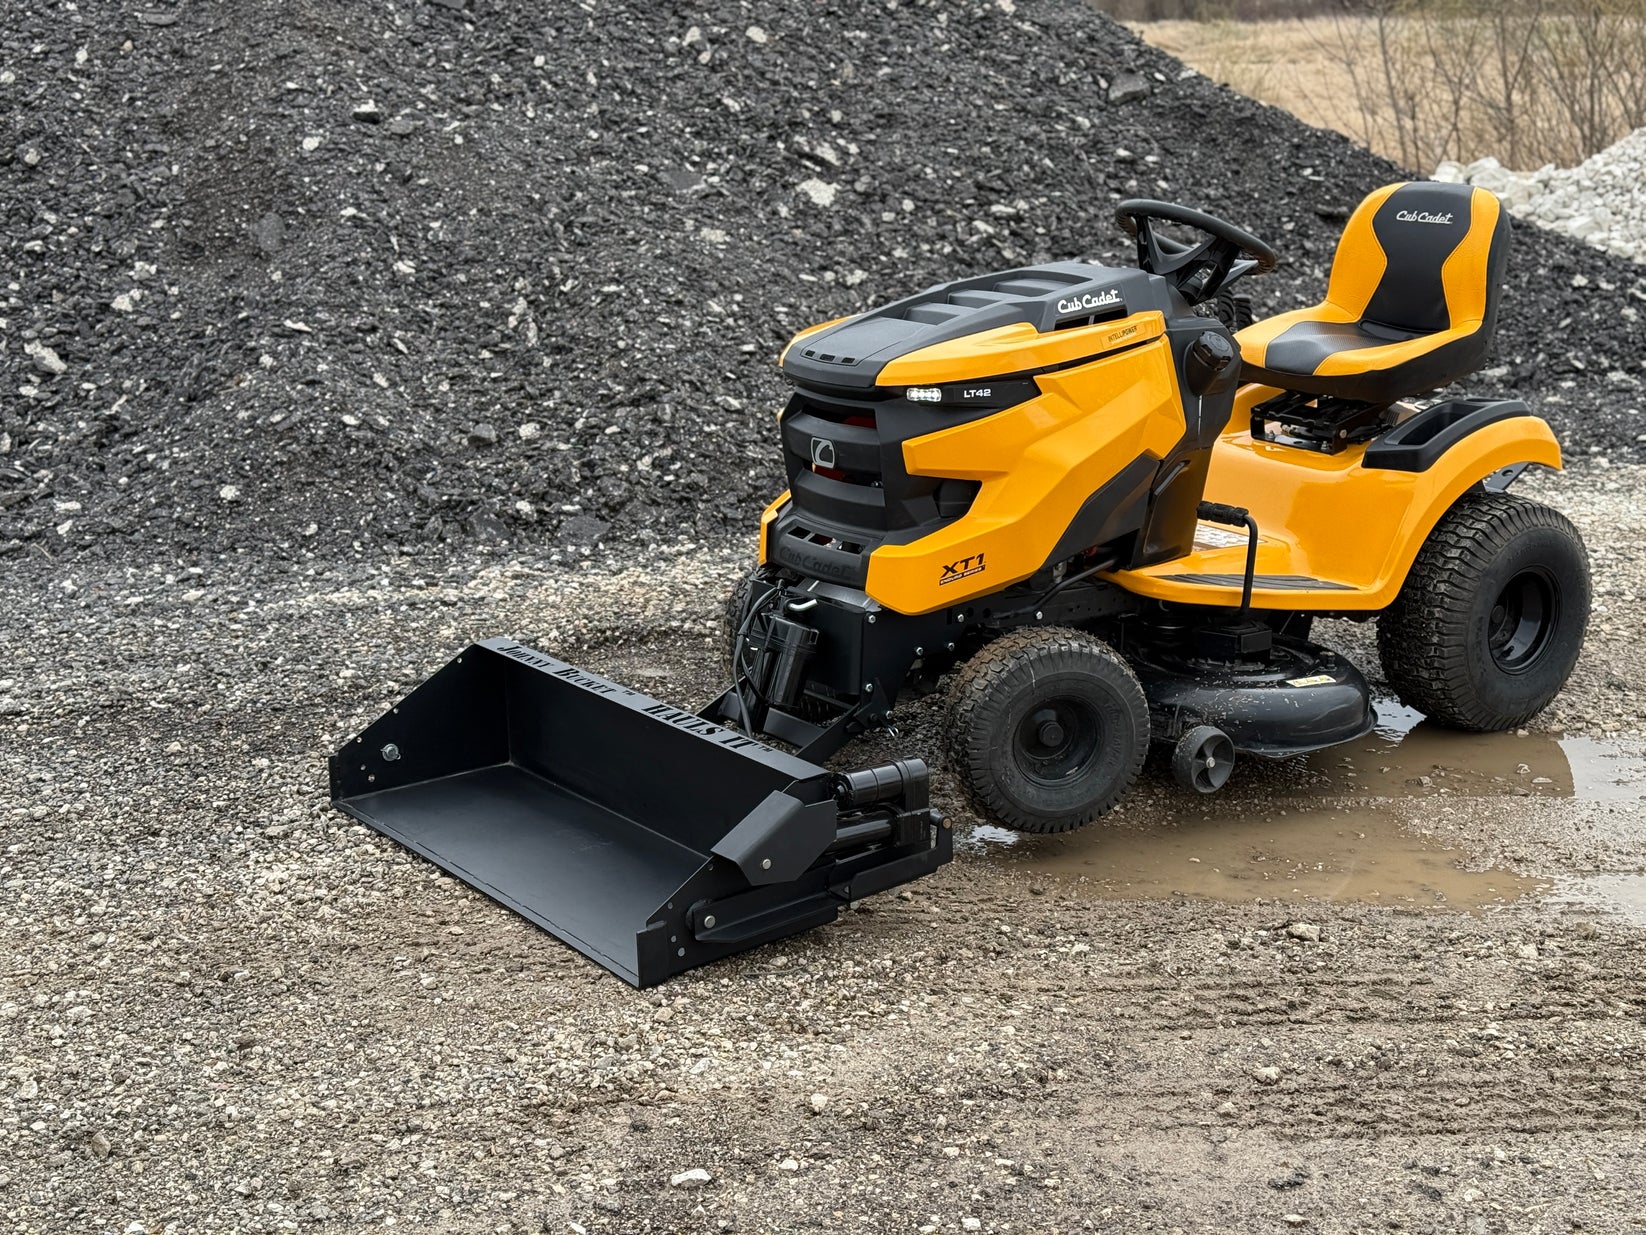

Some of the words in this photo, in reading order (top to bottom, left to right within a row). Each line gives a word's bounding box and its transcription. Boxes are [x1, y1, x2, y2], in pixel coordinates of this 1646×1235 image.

[1396, 210, 1418, 222] Cub
[1417, 212, 1454, 224] Cadet
[1057, 296, 1082, 314] Cub
[1082, 289, 1120, 308] Cadet
[963, 388, 992, 398] LT42
[780, 546, 802, 566] Cub
[940, 552, 985, 578] XT1
[641, 704, 724, 736] HAULS
